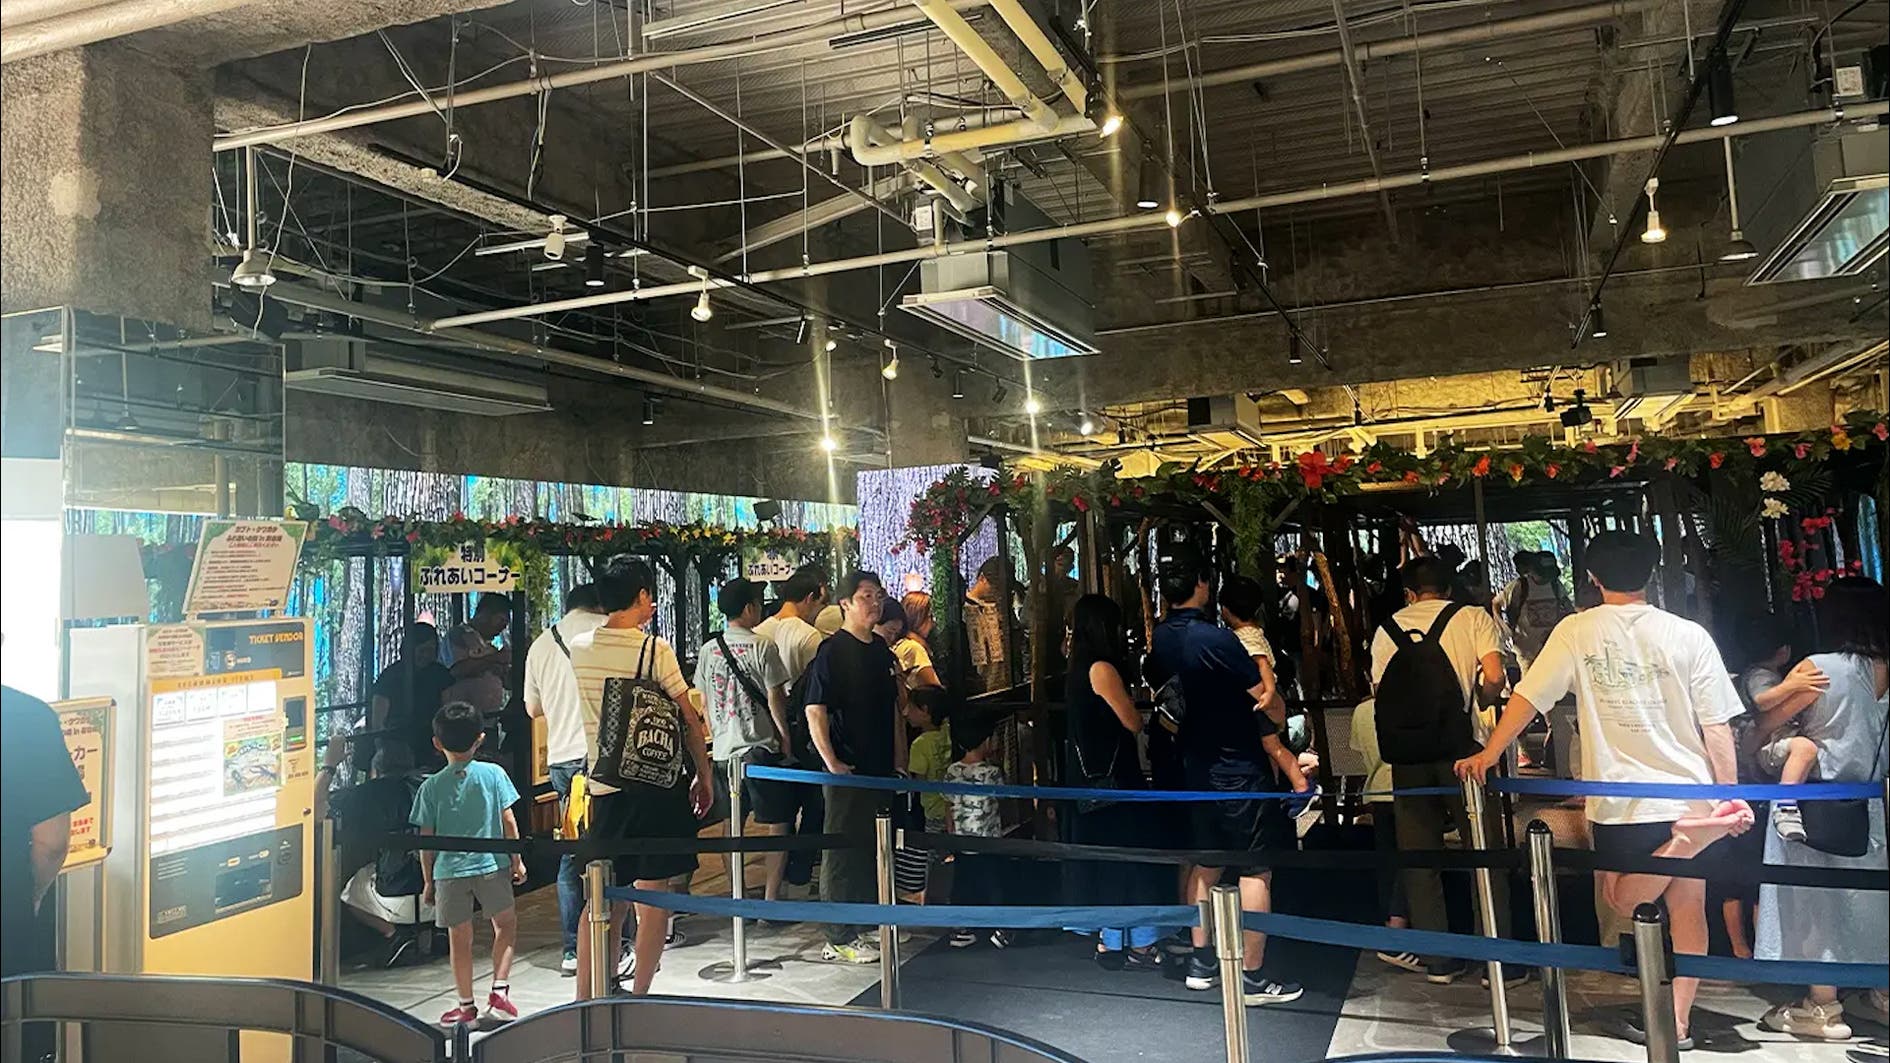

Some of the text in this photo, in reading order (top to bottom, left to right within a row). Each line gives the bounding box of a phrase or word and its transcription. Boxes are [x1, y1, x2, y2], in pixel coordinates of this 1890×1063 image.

[420, 567, 521, 586] ふれあいコーナー
[248, 633, 274, 645] TICKET
[636, 729, 674, 758] BACHA
[641, 747, 669, 760] COFFEE
